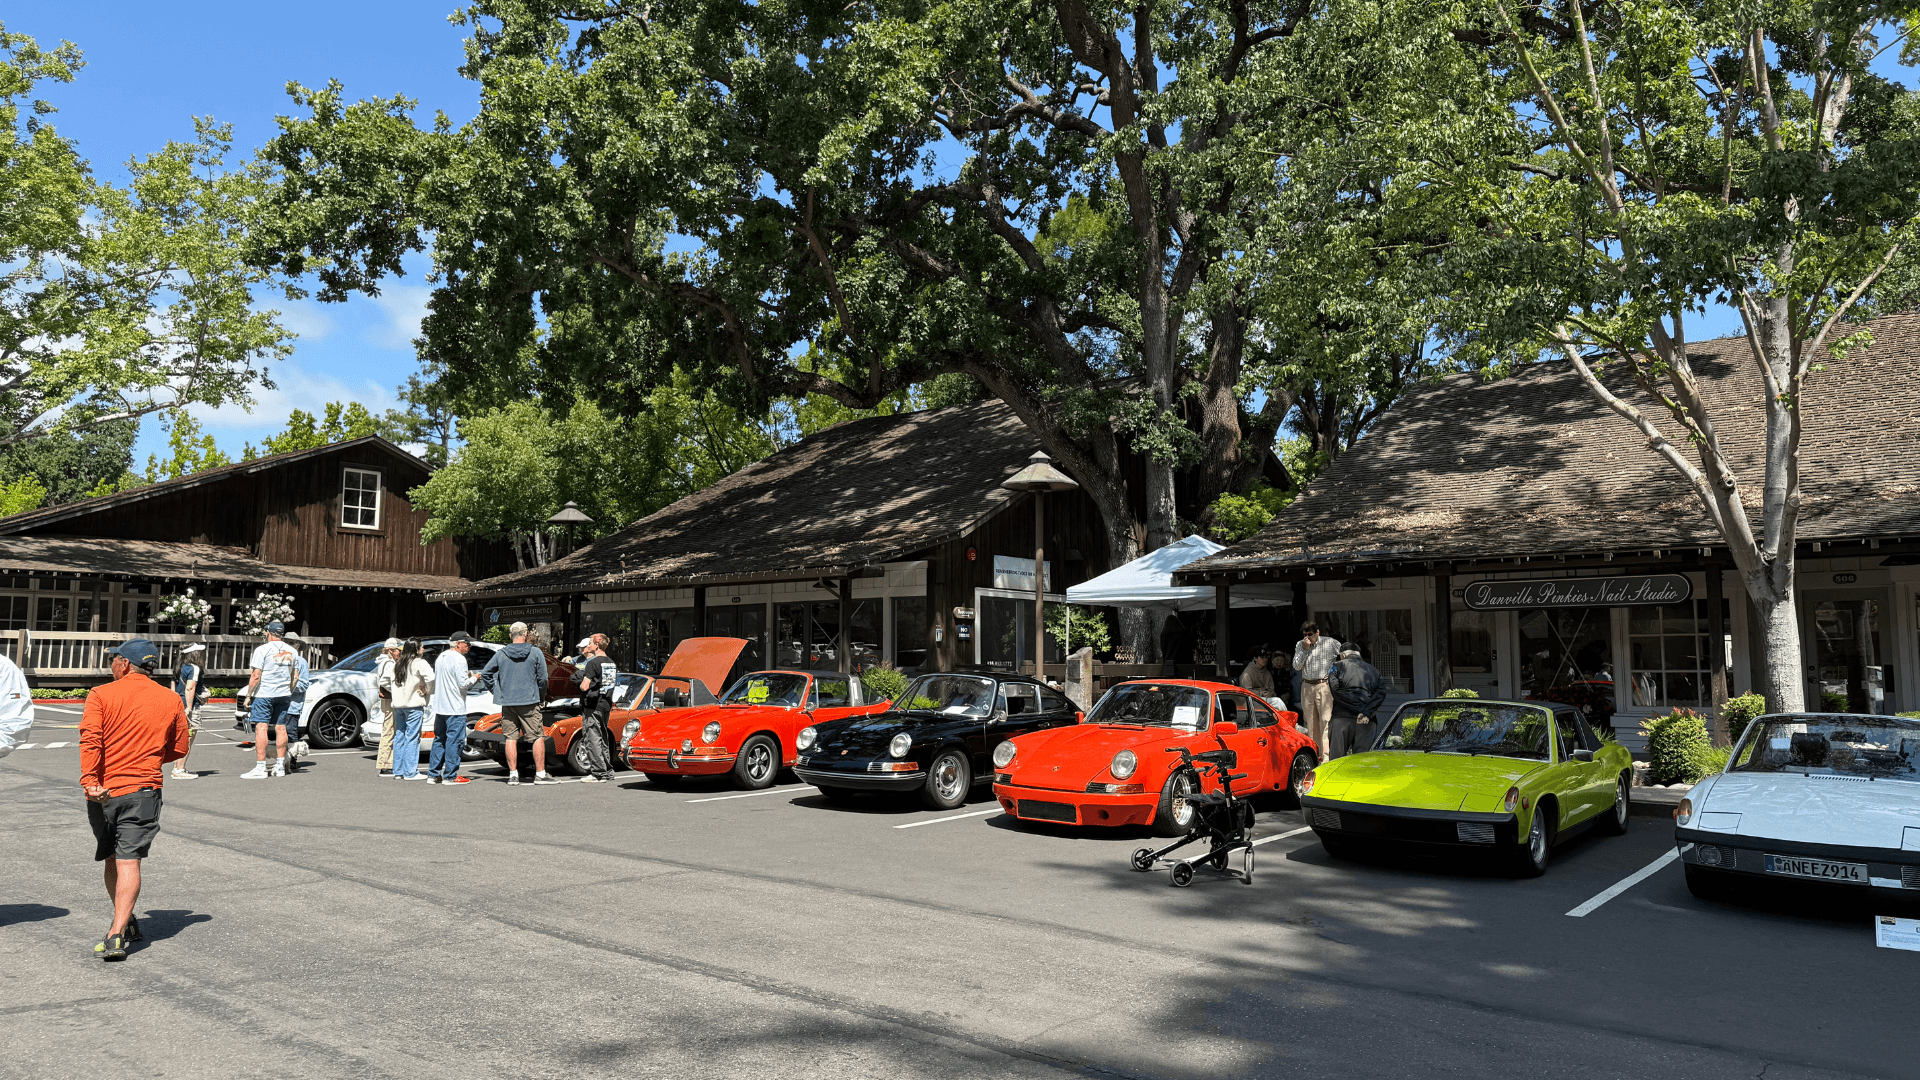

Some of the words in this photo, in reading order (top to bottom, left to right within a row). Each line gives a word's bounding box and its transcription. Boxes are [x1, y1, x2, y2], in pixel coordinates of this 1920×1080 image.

[1835, 575, 1854, 583] 506
[1475, 585, 1533, 605] Danville
[1537, 582, 1589, 604] Pinkies
[1590, 579, 1626, 602] Nail
[1628, 578, 1678, 601] Studio
[1782, 859, 1859, 880] ÄNEEZ914
